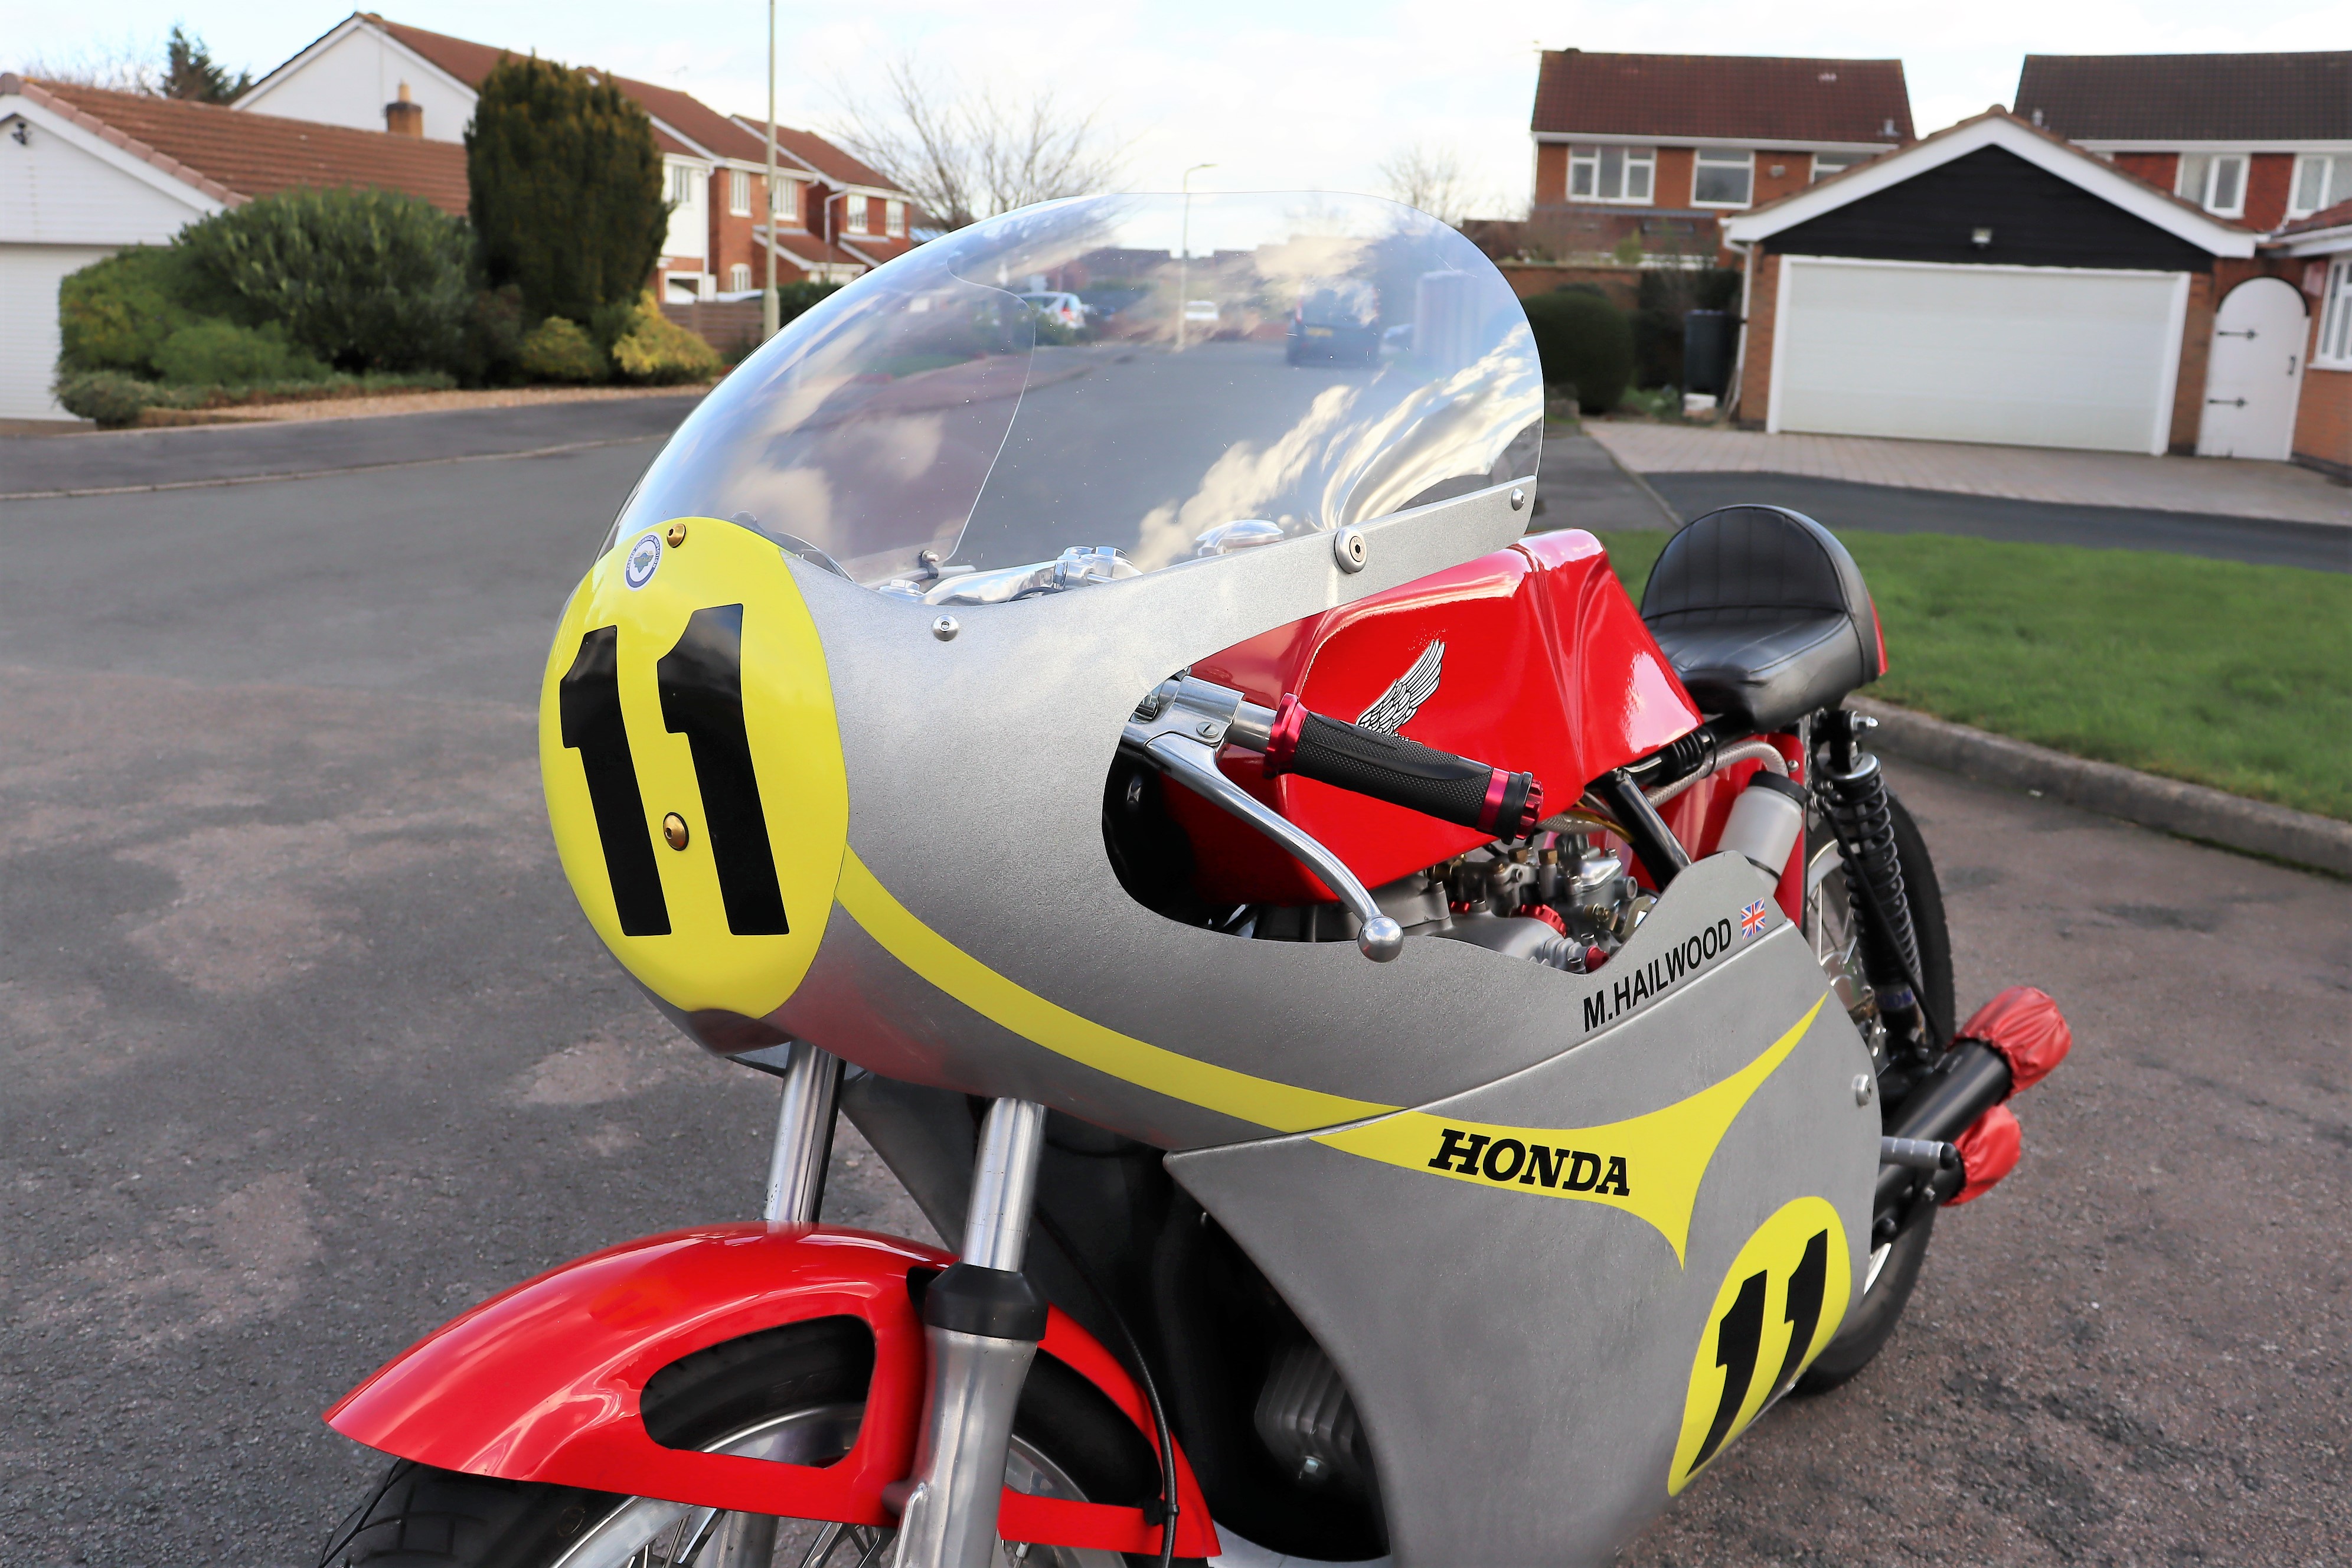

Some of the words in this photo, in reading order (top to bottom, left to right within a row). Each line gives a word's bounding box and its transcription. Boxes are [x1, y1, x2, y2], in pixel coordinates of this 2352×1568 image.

[559, 603, 789, 936] 11
[1583, 918, 1732, 1033] M.HAILWOOD
[1428, 1128, 1630, 1196] HONDA
[1685, 1229, 1827, 1479] 11
